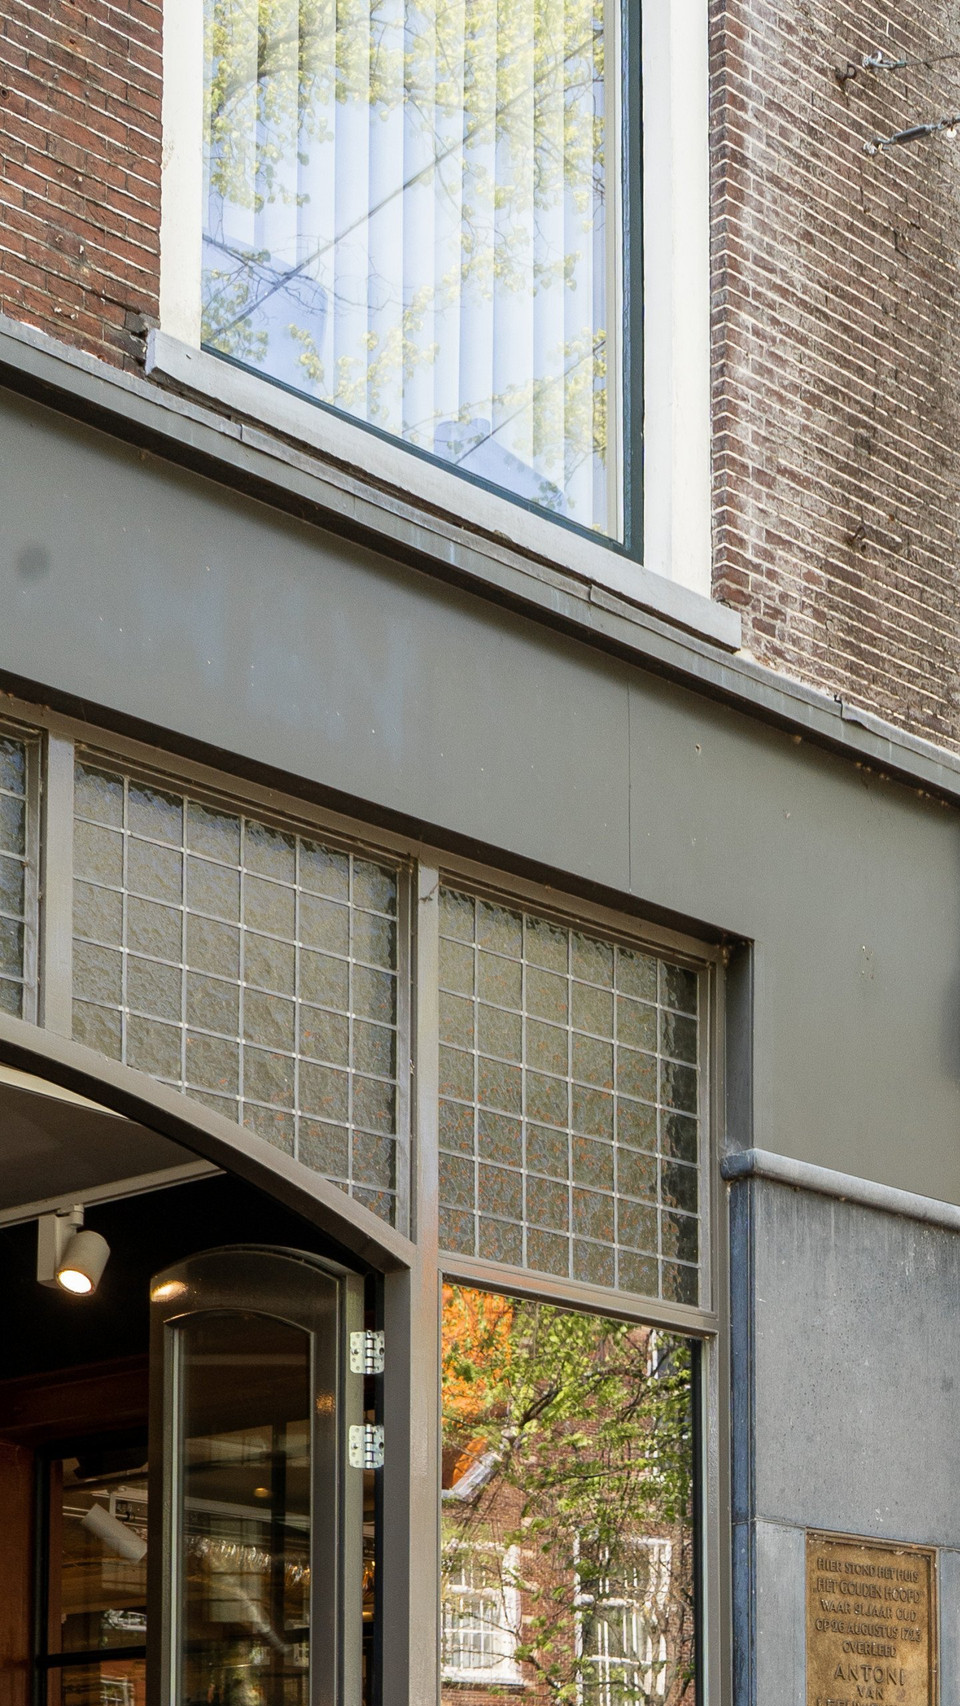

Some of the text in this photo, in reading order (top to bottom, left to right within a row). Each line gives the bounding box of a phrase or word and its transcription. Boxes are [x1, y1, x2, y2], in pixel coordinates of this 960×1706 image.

[817, 1558, 919, 1583] HIER STOND HET HUIS
[840, 1580, 882, 1599] GOUDEN
[821, 1600, 851, 1615] WAAR
[896, 1608, 917, 1622] OUD
[815, 1619, 830, 1632] OP
[847, 1622, 898, 1639] AUGUSTUS
[842, 1641, 897, 1658] OVERLEED
[834, 1663, 905, 1686] ANTONI
[857, 1685, 884, 1700] VAN
